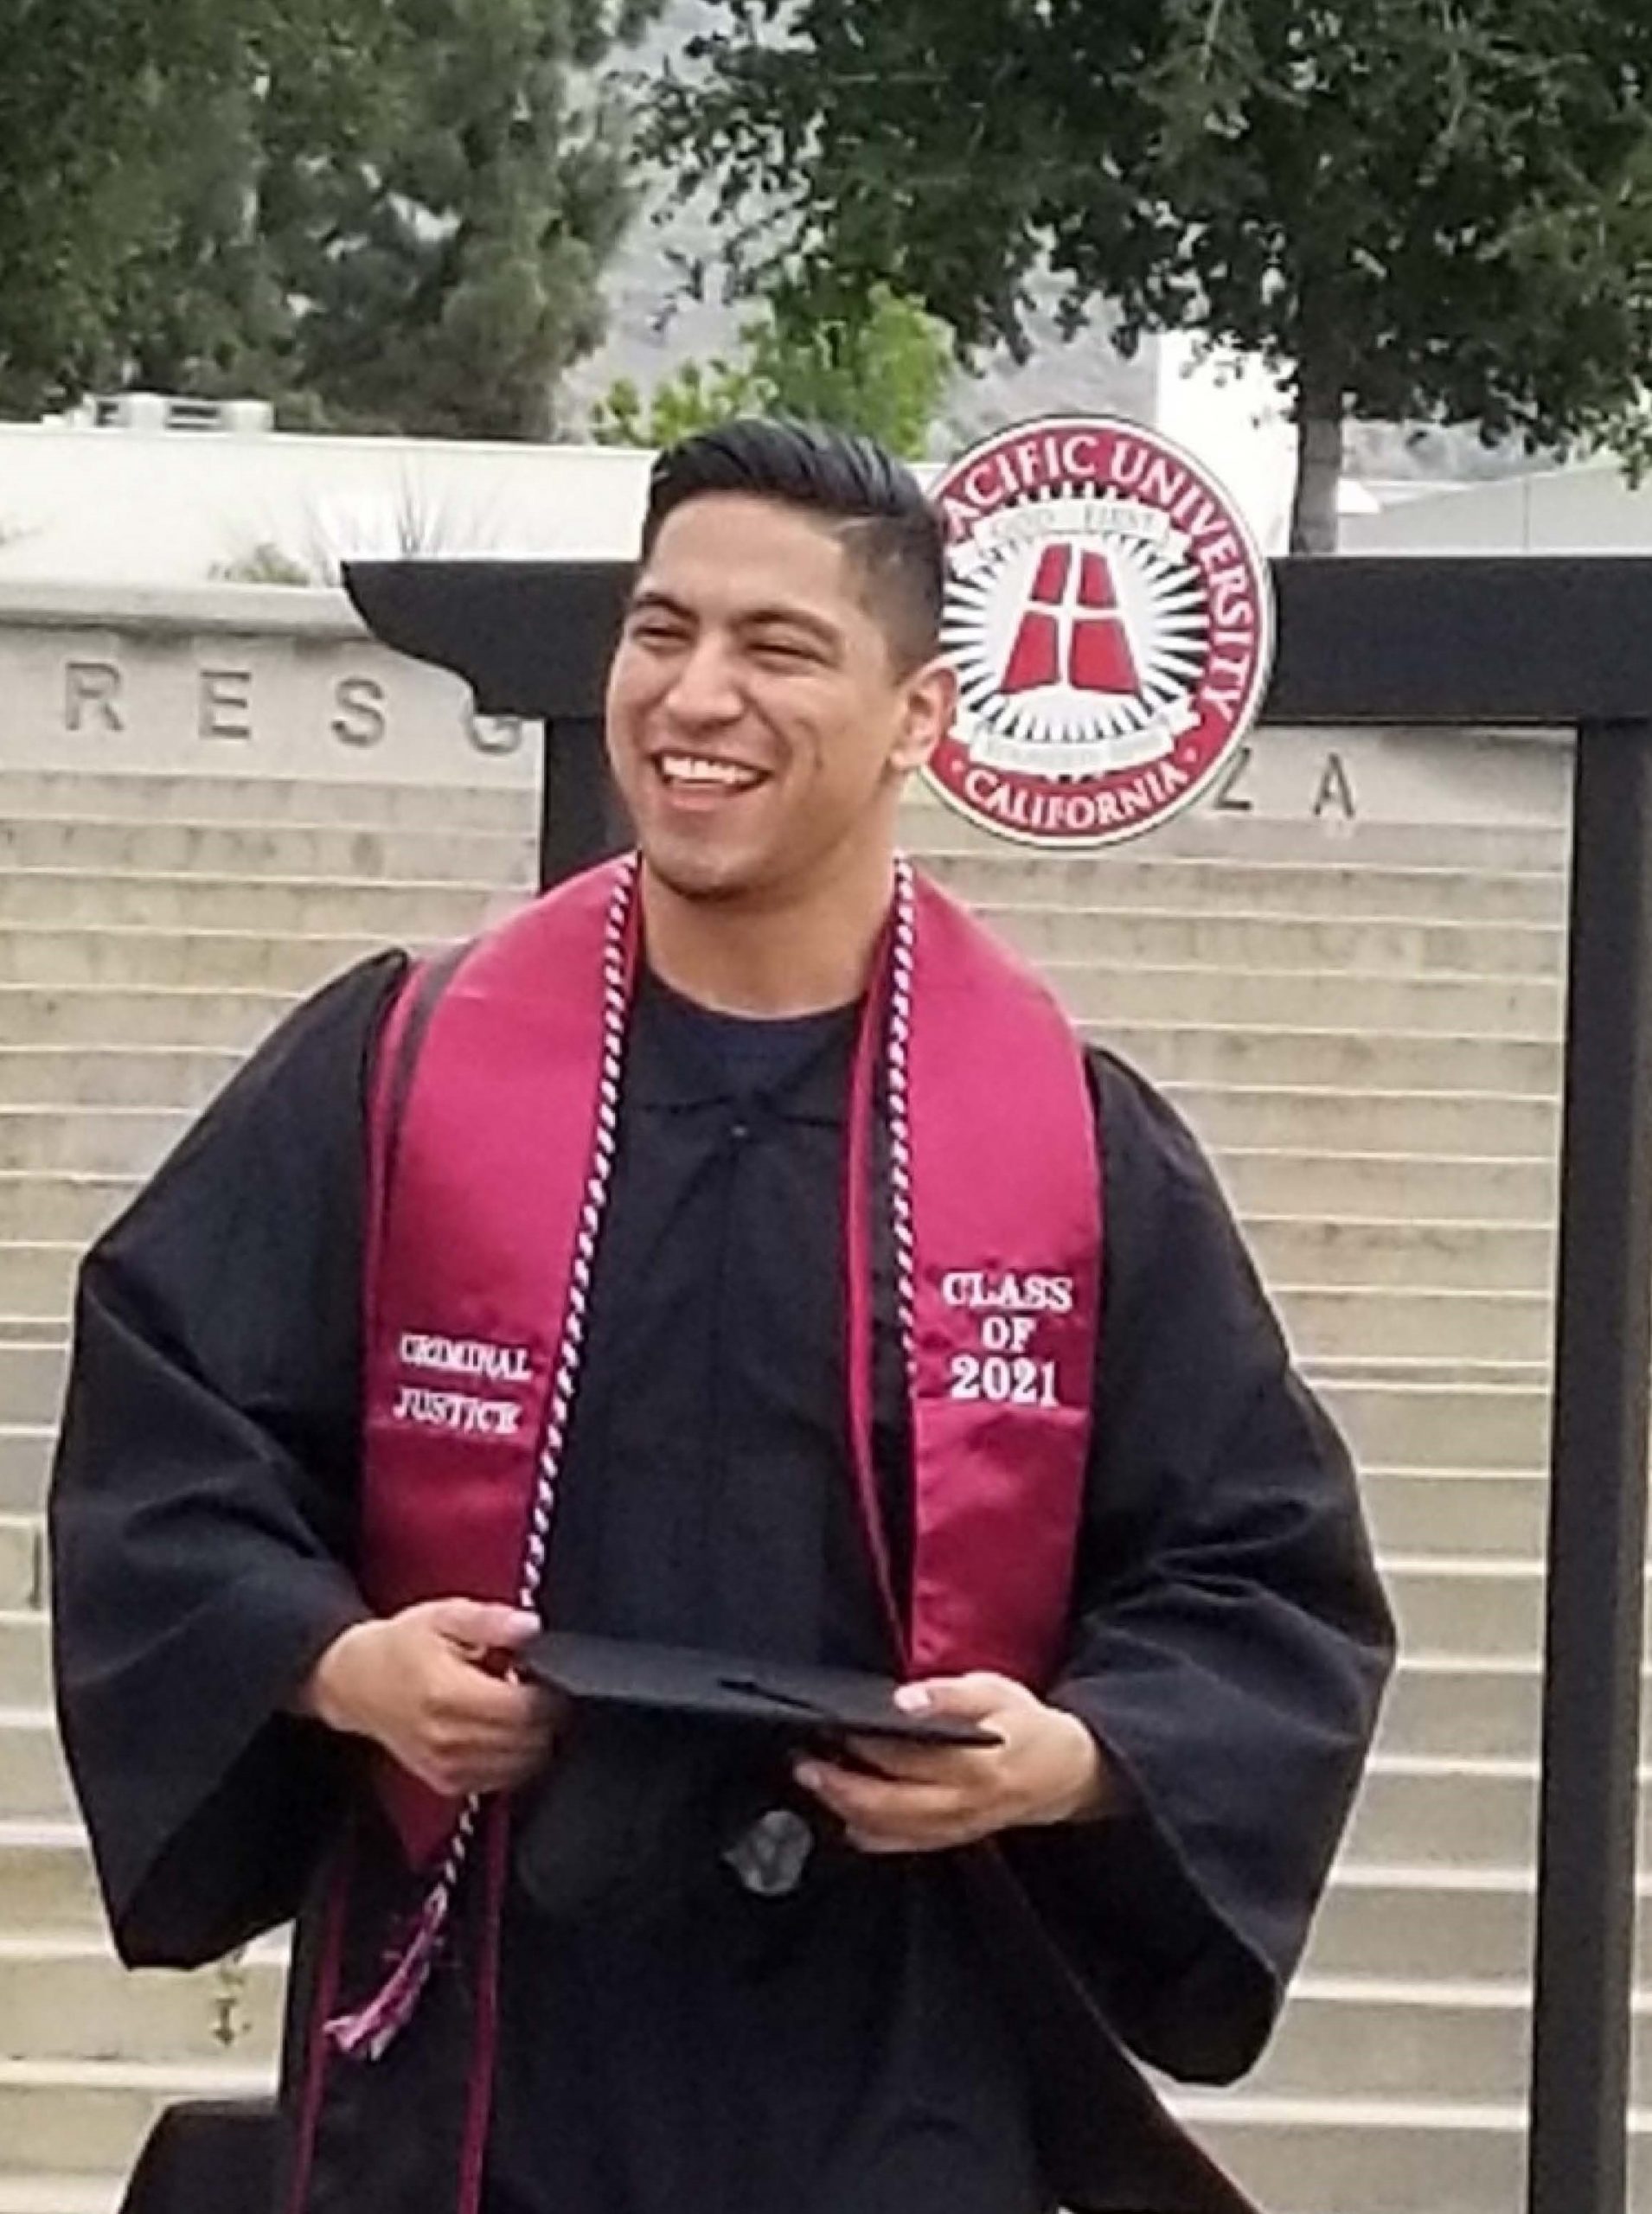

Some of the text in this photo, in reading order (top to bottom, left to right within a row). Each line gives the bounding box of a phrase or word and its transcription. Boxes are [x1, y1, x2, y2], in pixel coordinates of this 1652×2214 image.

[943, 435, 1255, 720] ACIFIC UNIVERSITY
[64, 661, 522, 755] RESG
[1212, 746, 1356, 817] ZA
[964, 763, 1190, 829] CALIFORNIA
[942, 1271, 1073, 1313] CLASS
[399, 1331, 534, 1382] CRIMINAL
[981, 1315, 1037, 1353] OF
[951, 1353, 1060, 1408] 2021
[392, 1386, 522, 1435] JUSTICE
